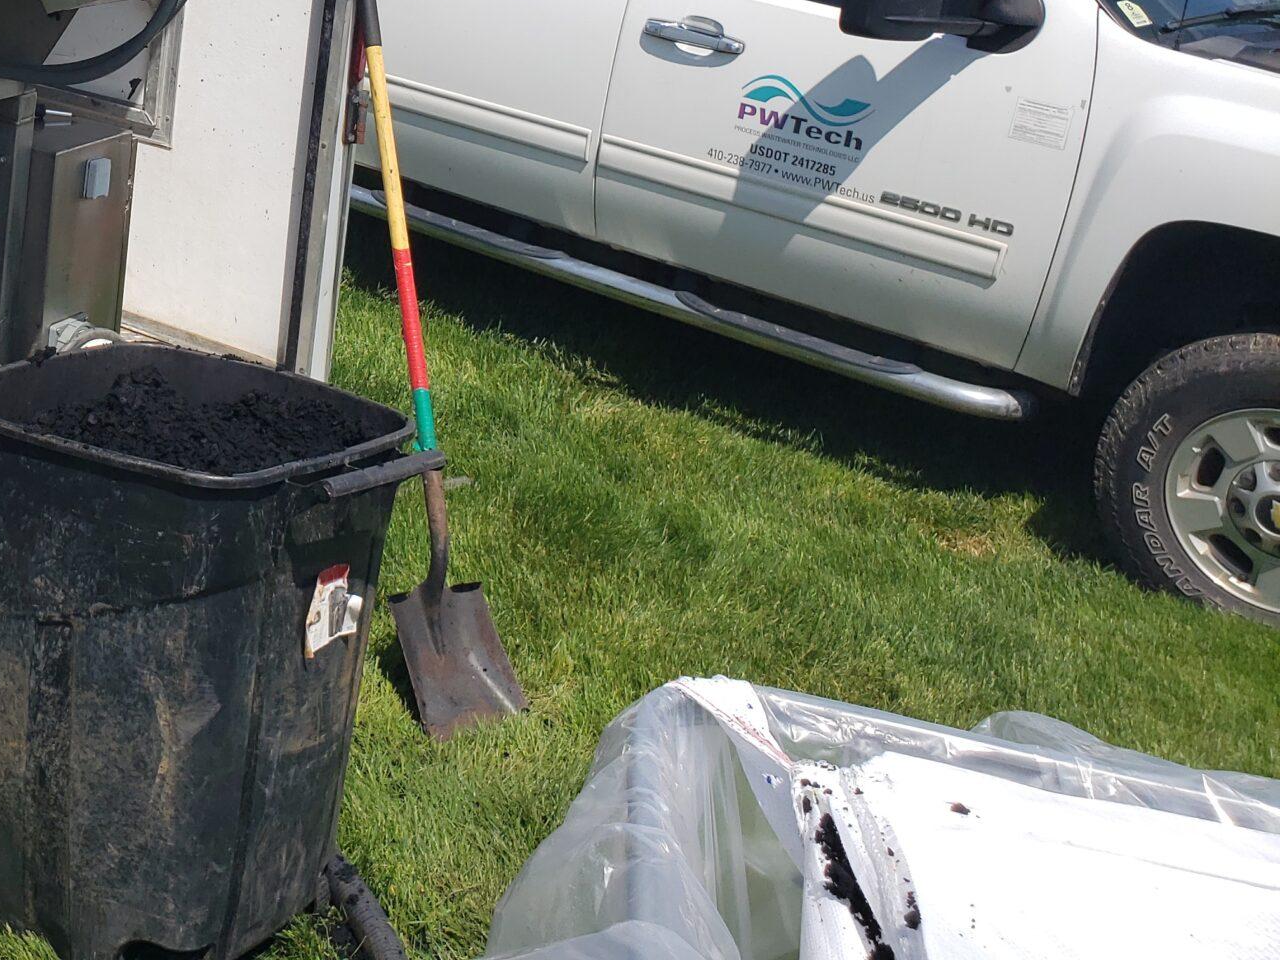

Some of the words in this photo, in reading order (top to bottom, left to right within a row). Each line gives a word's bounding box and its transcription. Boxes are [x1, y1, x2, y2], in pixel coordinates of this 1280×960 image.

[737, 102, 863, 151] PWTech
[707, 147, 773, 175] 410-238-7977
[781, 169, 876, 204] www.PWTech.us
[749, 143, 790, 163] USDOT
[791, 155, 836, 176] 2417285
[879, 190, 962, 224] 2500
[968, 213, 1015, 237] HD
[1136, 413, 1173, 473] A/T
